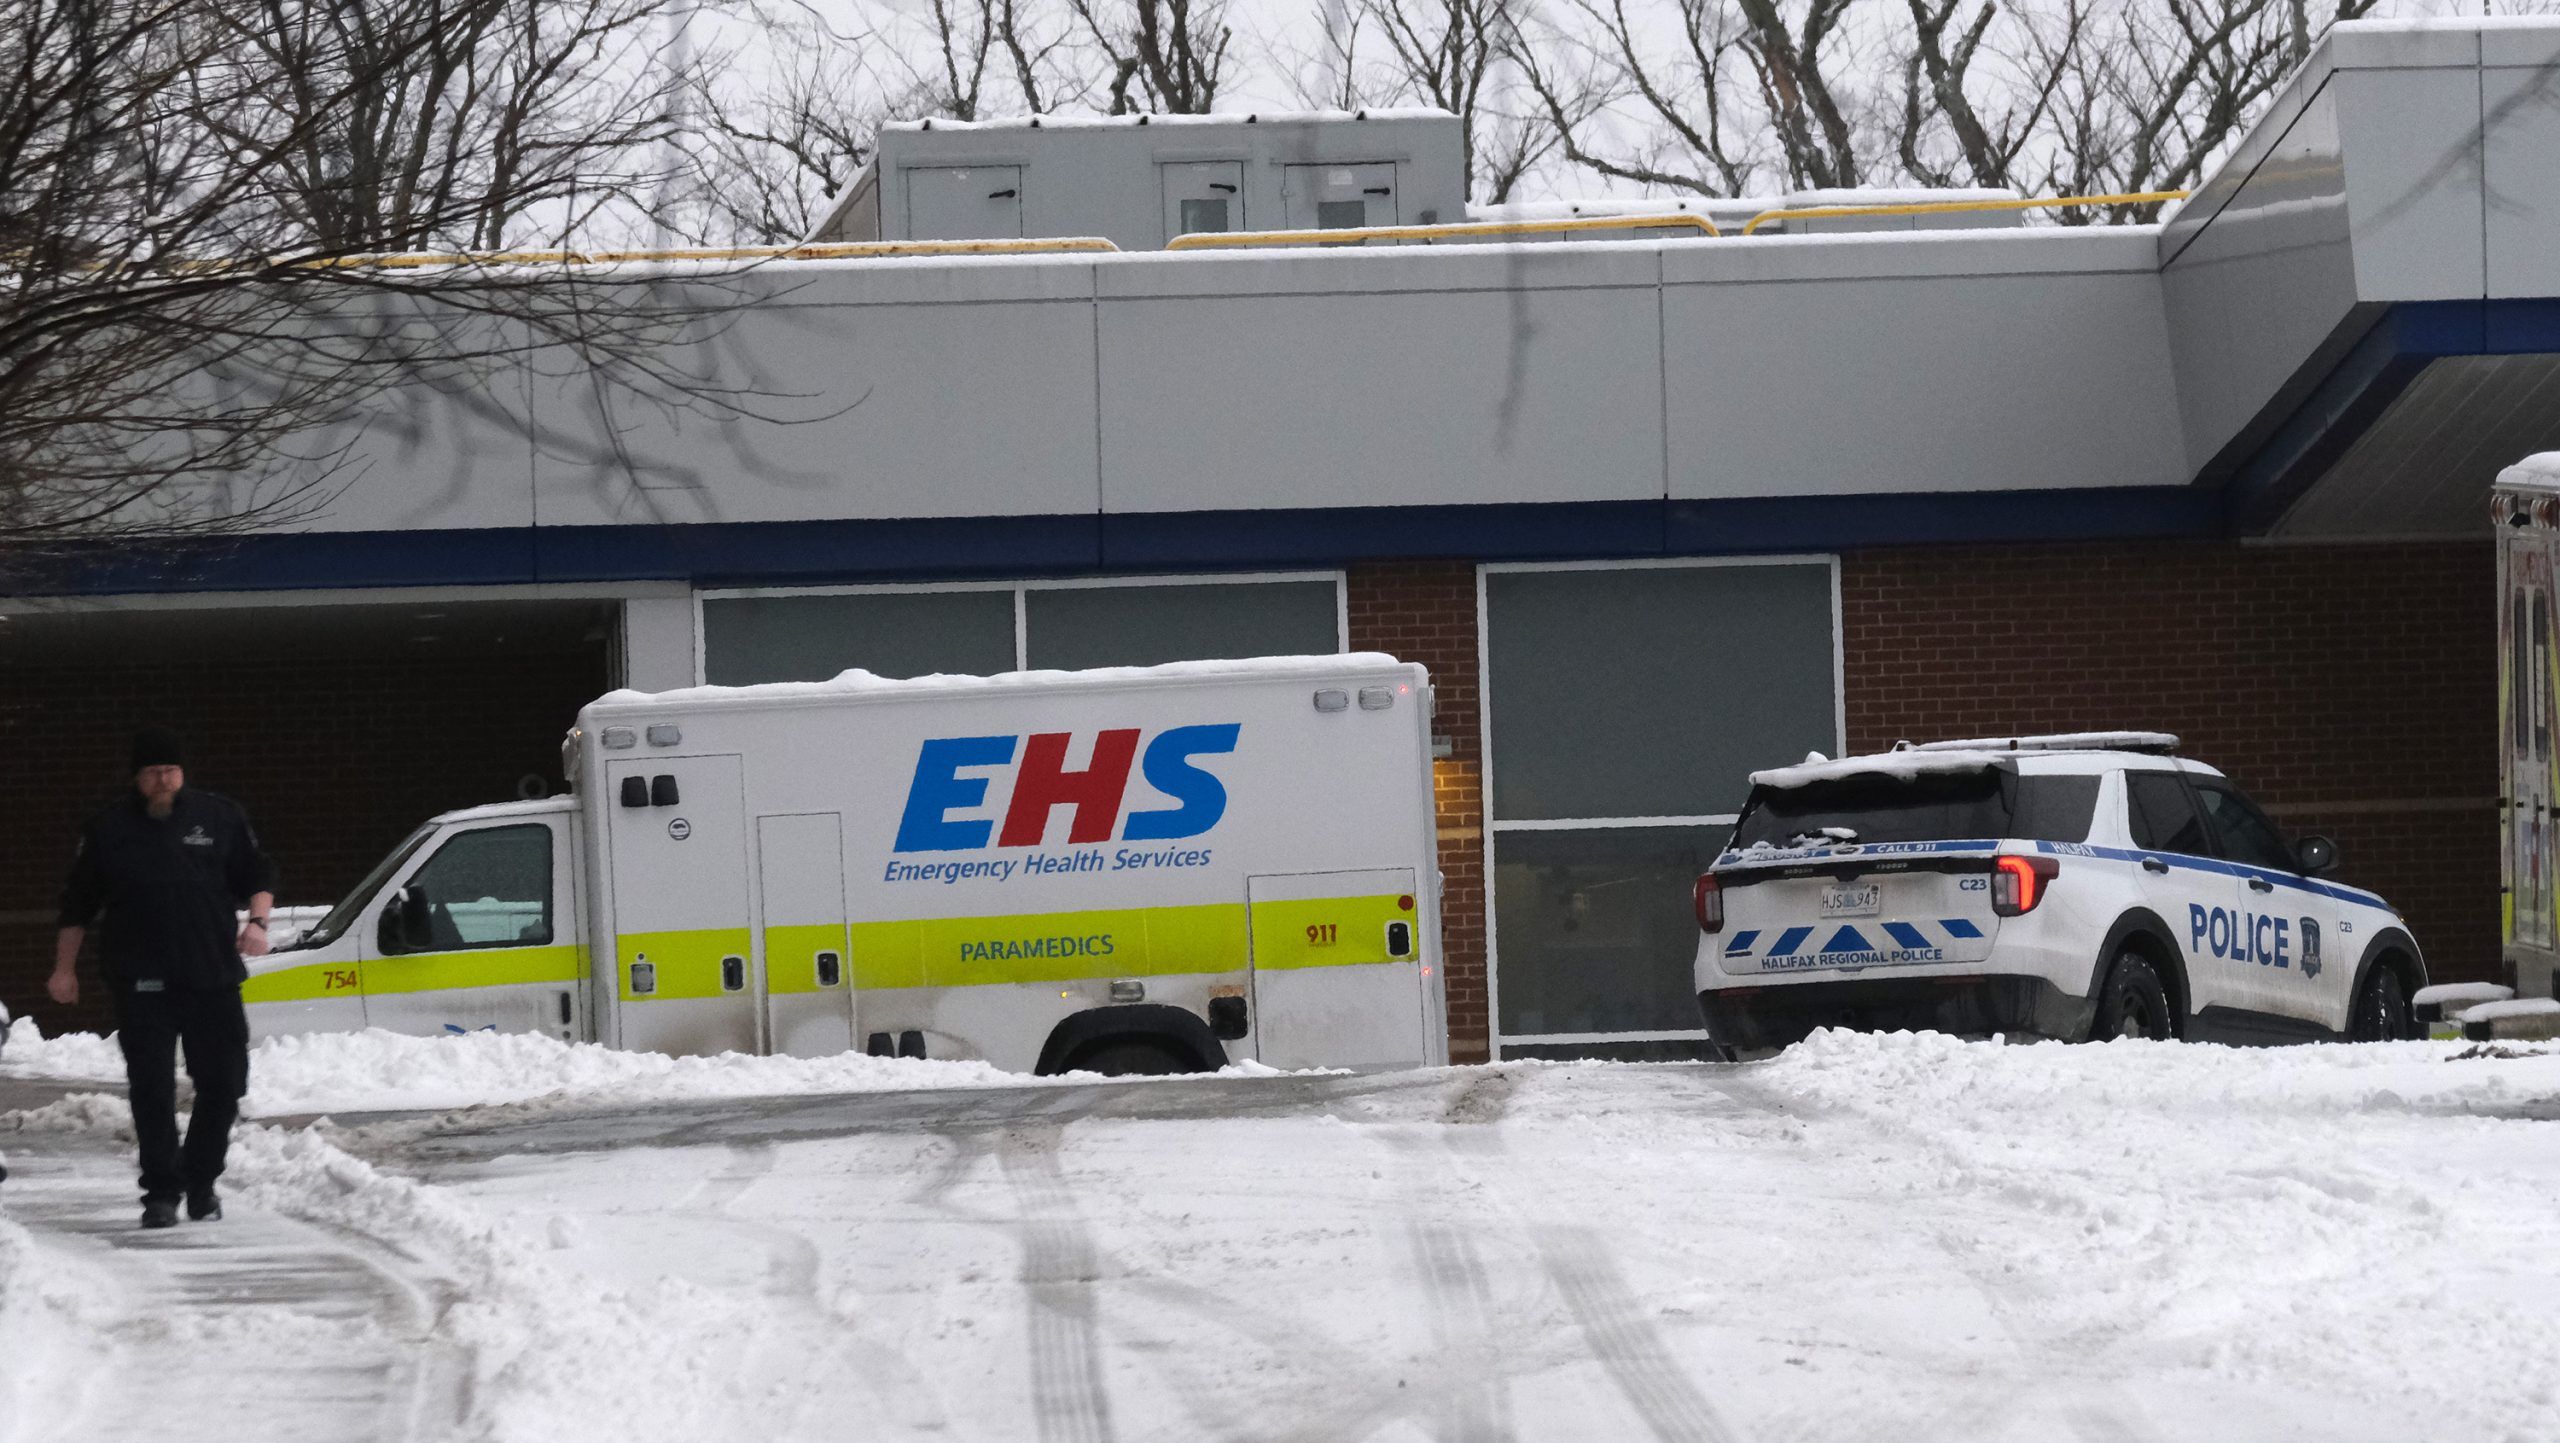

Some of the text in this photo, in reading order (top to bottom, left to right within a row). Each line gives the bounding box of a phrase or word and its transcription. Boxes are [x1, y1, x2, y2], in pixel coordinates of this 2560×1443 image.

[893, 722, 1241, 852] EHS
[1877, 843, 1936, 854] CALL 911
[884, 846, 1212, 884] Emergency Health Services
[1959, 879, 1987, 891] C23
[1822, 891, 1878, 909] HJS 943
[1306, 923, 1337, 943] 911
[2188, 902, 2290, 968] POLICE
[2339, 920, 2353, 933] C23
[960, 934, 1115, 962] PARAMEDICS
[1761, 948, 1943, 970] HALIFAX REGIONAL POLICE
[323, 970, 357, 989] 754
